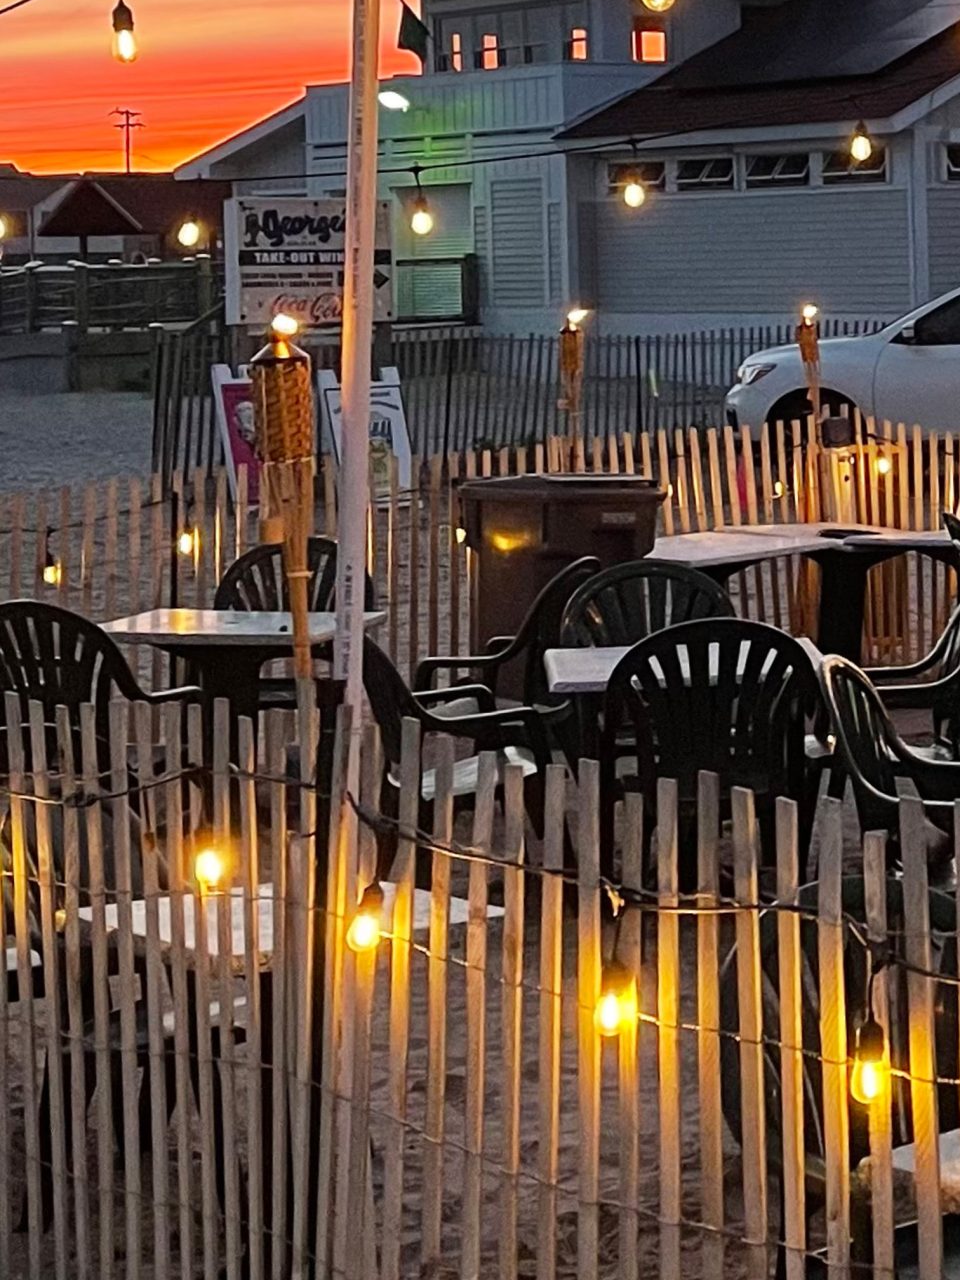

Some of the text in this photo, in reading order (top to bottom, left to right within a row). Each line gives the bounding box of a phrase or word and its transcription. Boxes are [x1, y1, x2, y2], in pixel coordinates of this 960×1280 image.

[262, 208, 345, 247] George'
[254, 252, 345, 263] TAKE-OUT WIN
